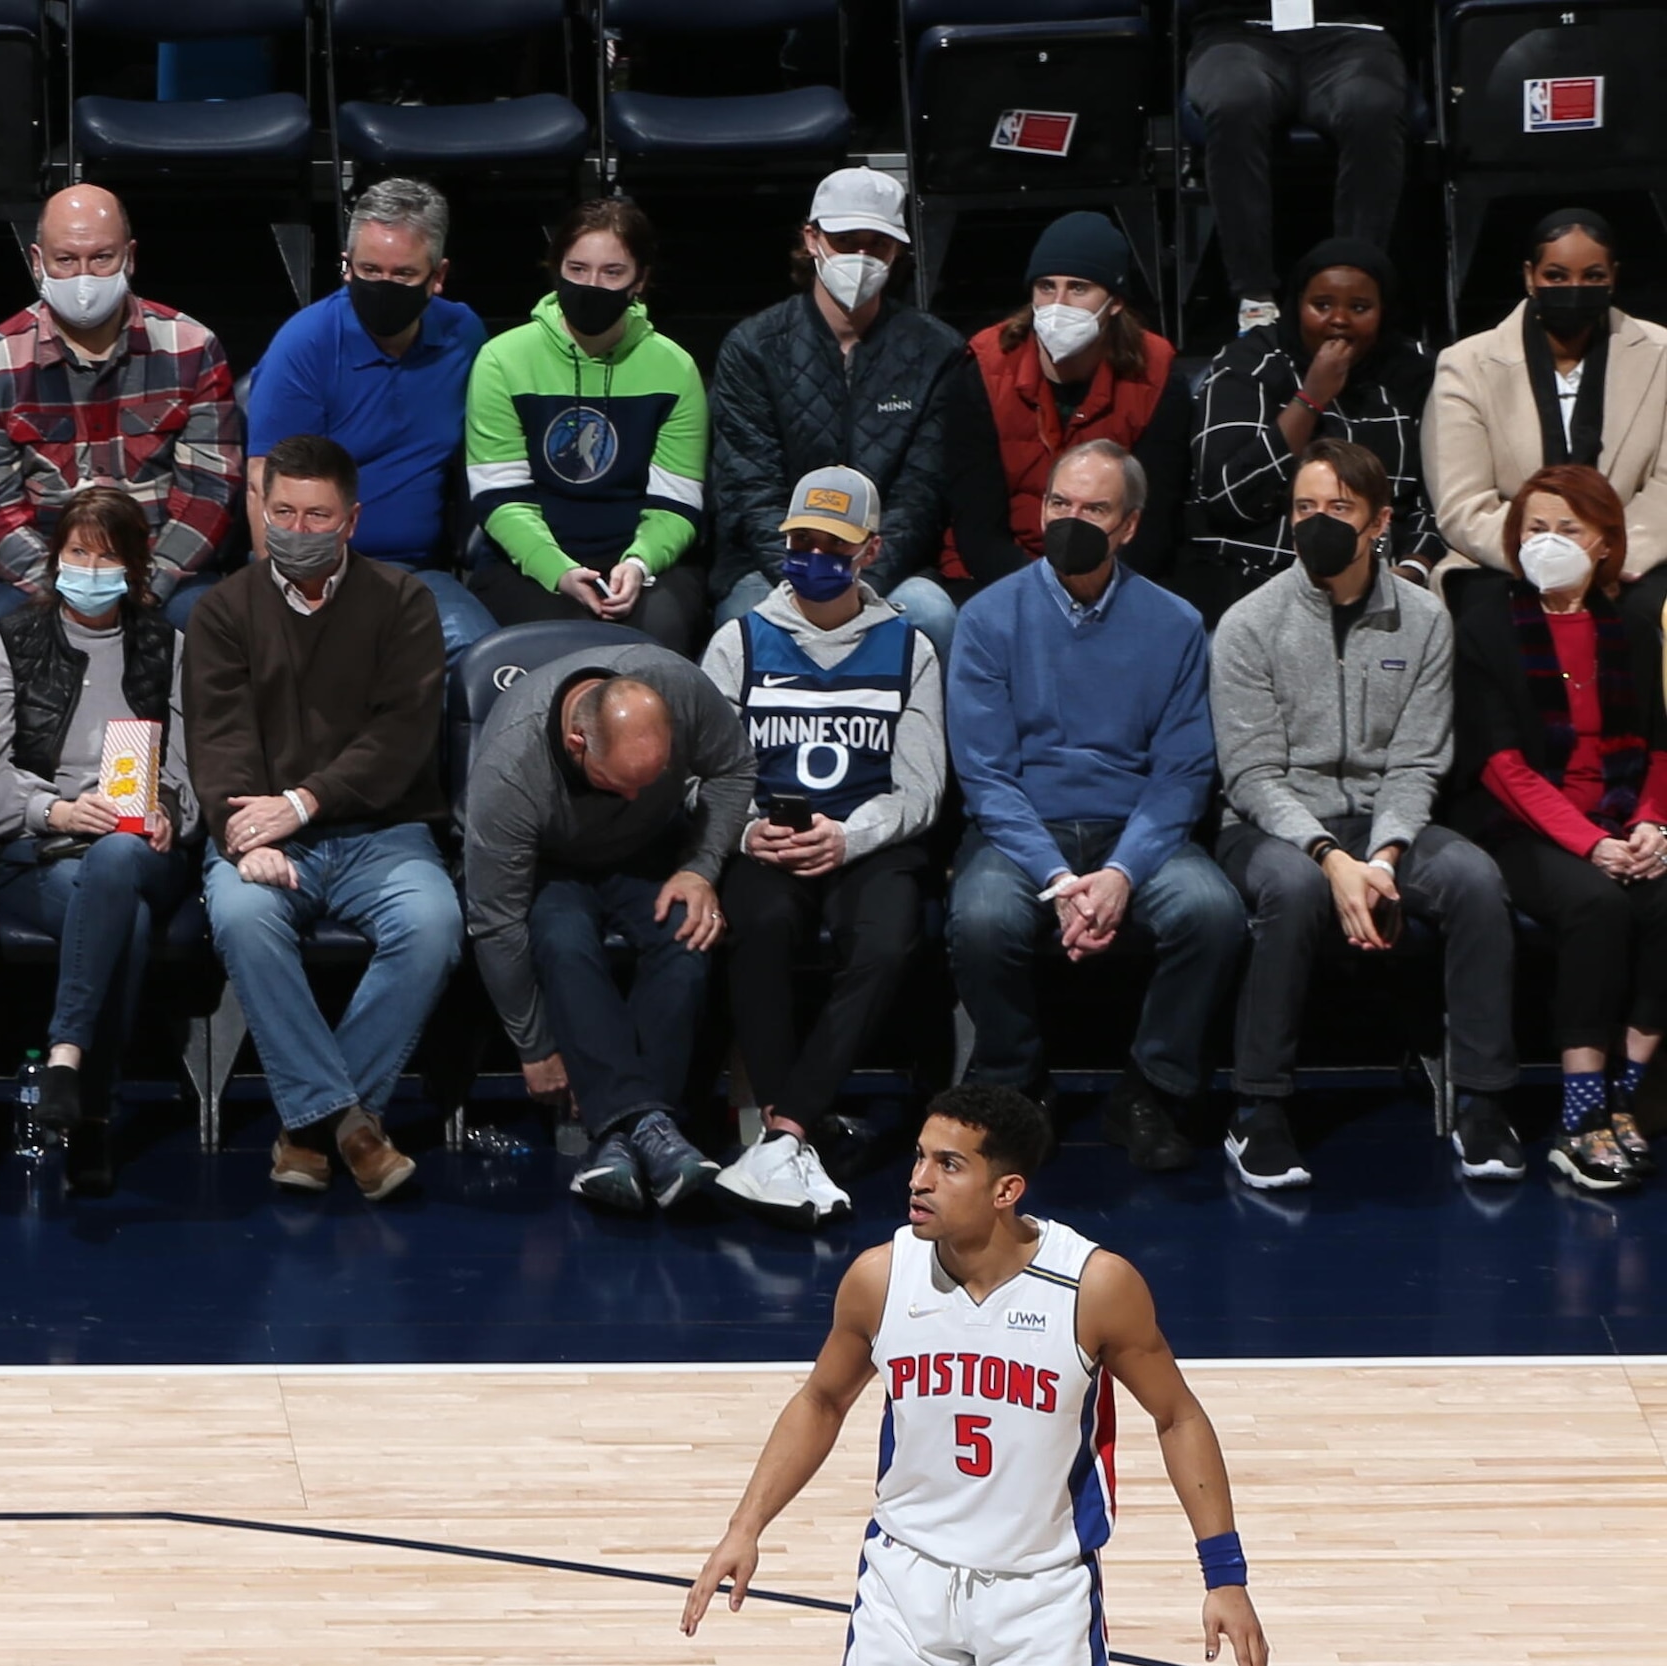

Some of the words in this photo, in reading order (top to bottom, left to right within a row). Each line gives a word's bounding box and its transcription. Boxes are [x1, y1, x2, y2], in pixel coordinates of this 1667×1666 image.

[877, 400, 913, 413] MINN
[749, 716, 891, 752] MINNESOTA
[1008, 1311, 1046, 1327] UWM
[886, 1352, 1061, 1414] PISTONS
[954, 1414, 993, 1478] 5
